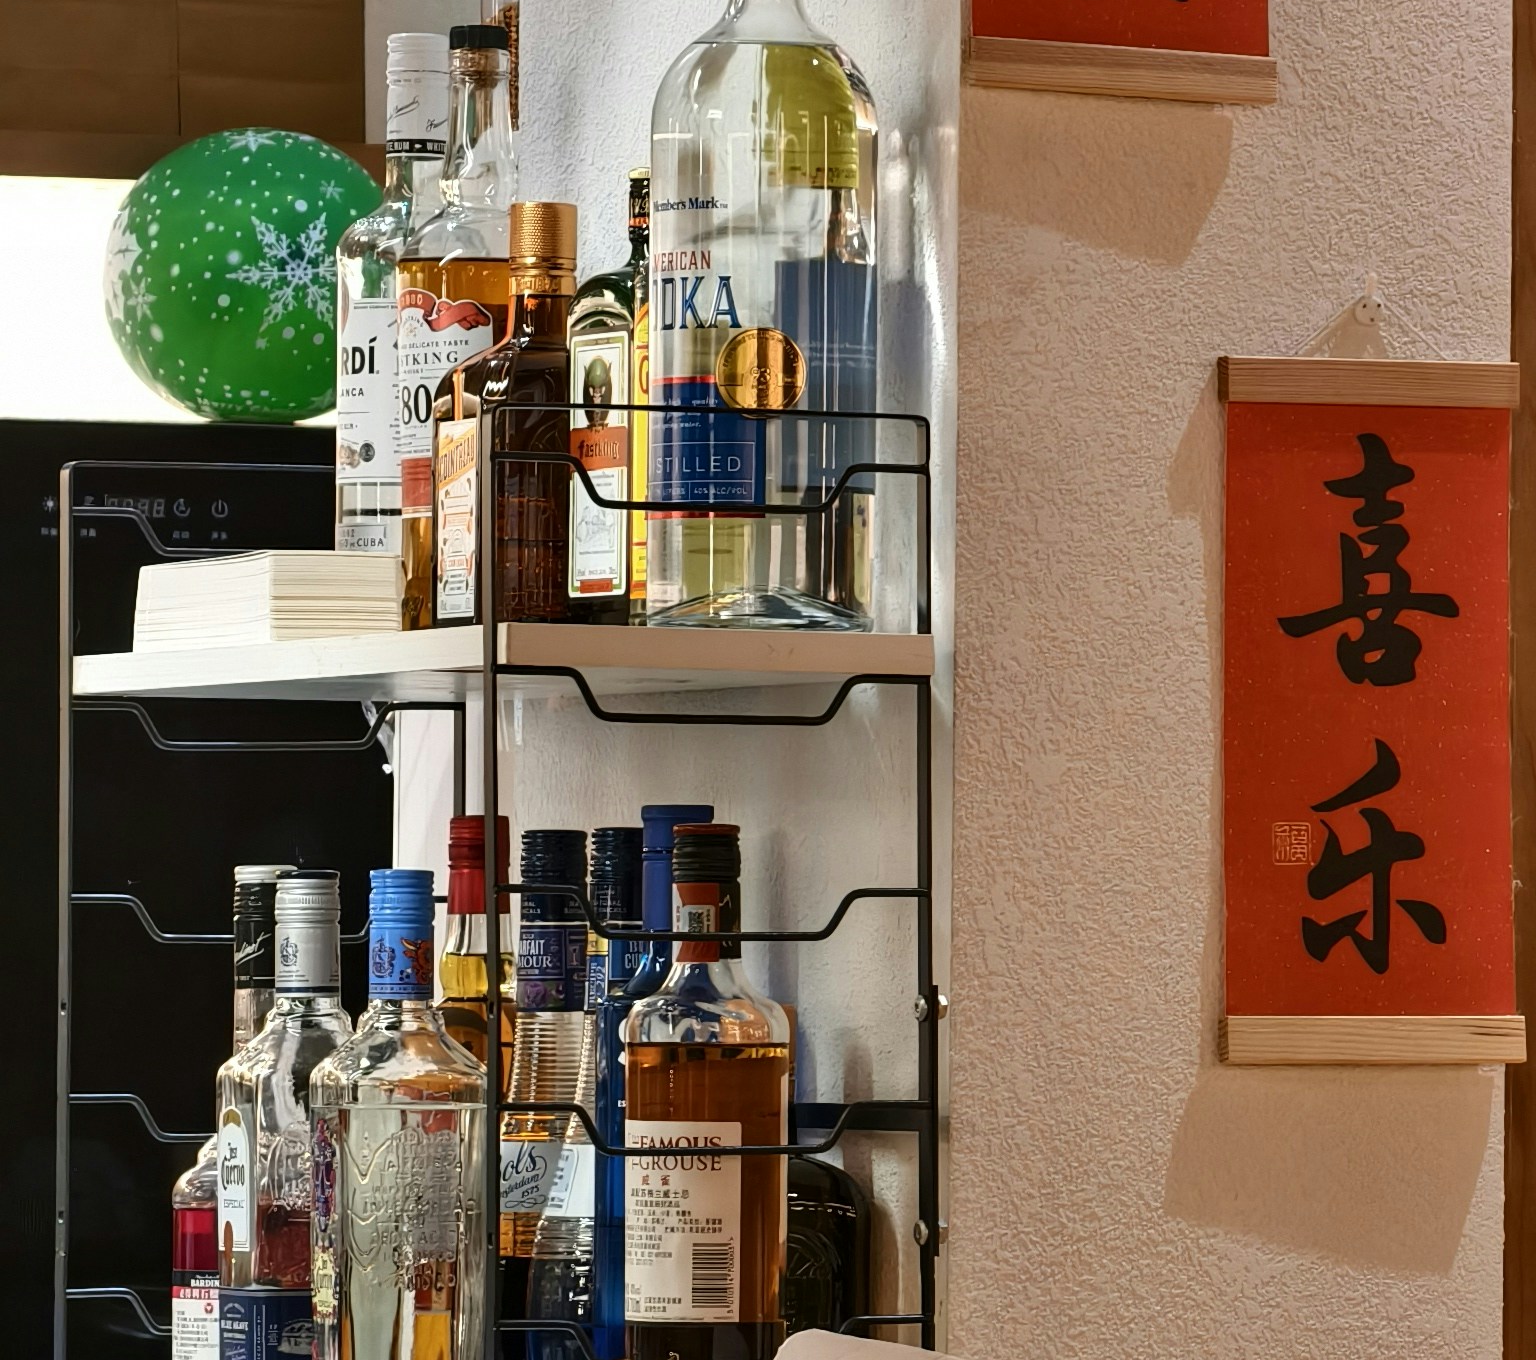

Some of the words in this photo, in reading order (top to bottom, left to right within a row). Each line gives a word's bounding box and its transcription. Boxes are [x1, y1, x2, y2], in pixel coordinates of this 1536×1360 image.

[653, 275, 742, 330] DKA
[656, 455, 741, 473] STILLED
[356, 537, 385, 548] CUBA
[1276, 433, 1460, 975] 喜乐
[640, 1135, 722, 1149] FAMOUS
[500, 1142, 540, 1183] ols
[639, 1155, 722, 1171] GROUSE
[521, 1184, 540, 1198] 1575
